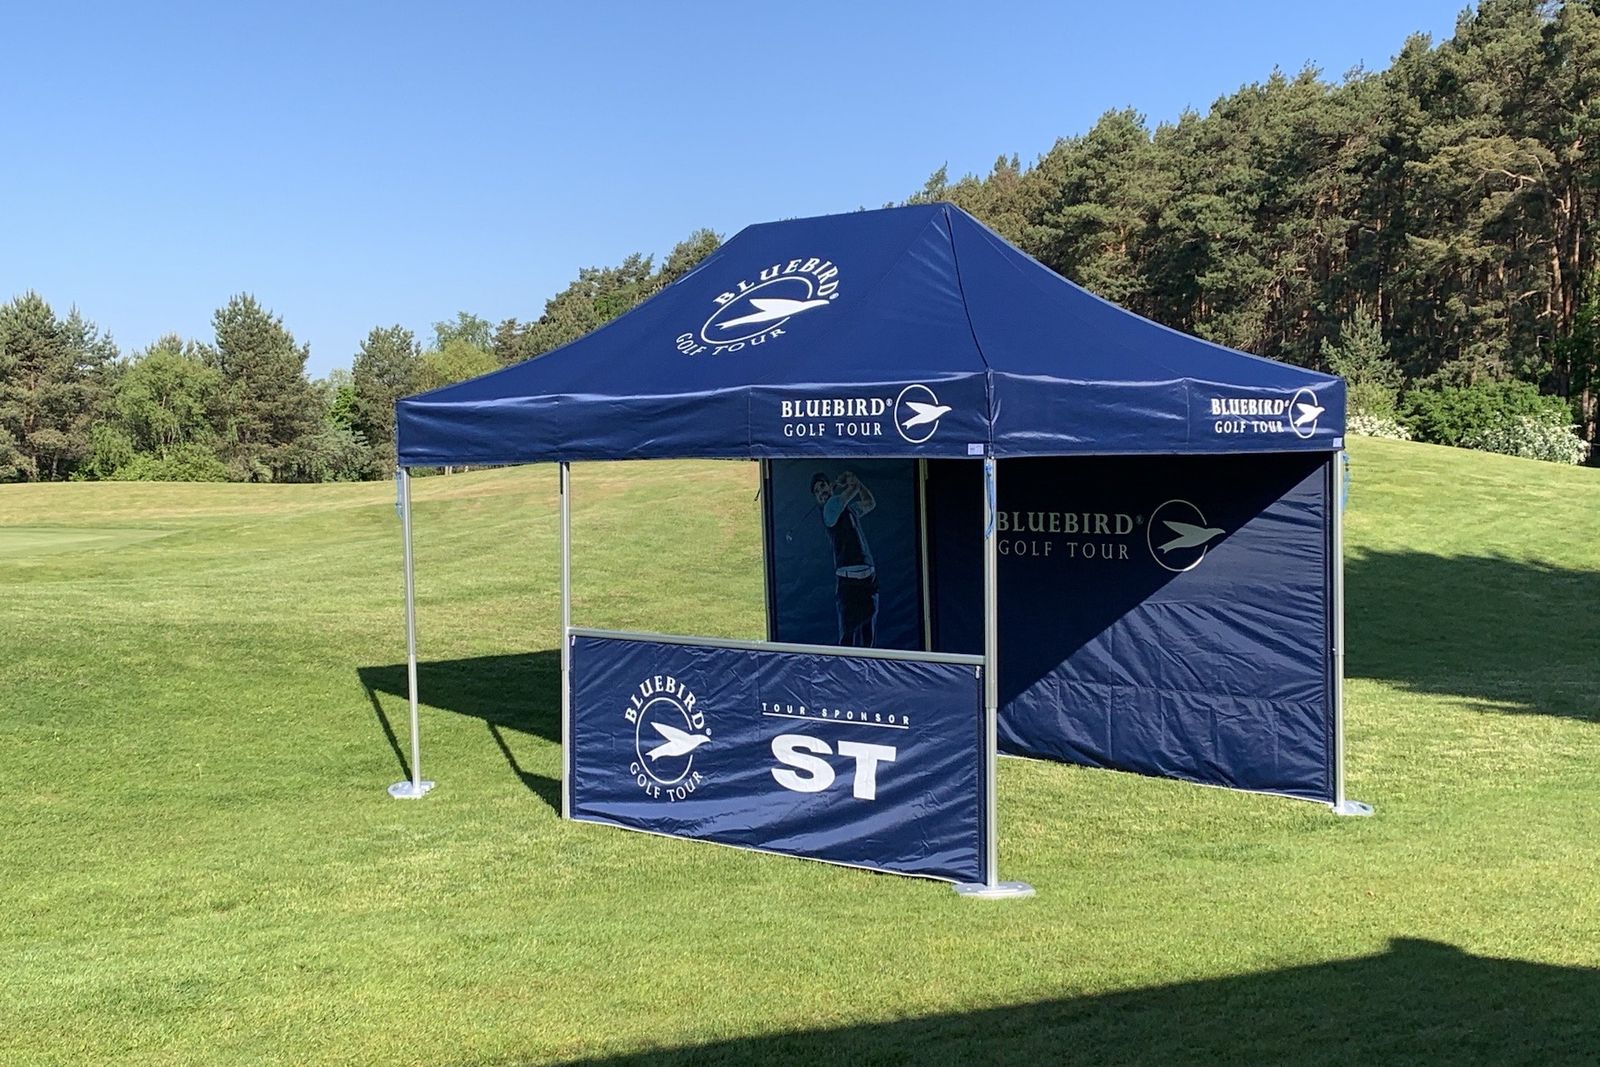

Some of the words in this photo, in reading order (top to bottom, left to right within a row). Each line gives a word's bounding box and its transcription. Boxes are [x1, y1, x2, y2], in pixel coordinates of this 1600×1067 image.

[676, 333, 707, 356] GOLF
[712, 329, 786, 356] TOUR
[784, 424, 826, 437] GOLF
[836, 423, 882, 436] TOUR
[1215, 421, 1246, 433] GOLF
[1252, 421, 1284, 433] TOUR
[998, 540, 1052, 556] GOLF
[1067, 542, 1129, 560] TOUR
[762, 702, 805, 715] TOUR
[822, 708, 909, 725] SPONSOR
[771, 734, 897, 800] ST
[630, 762, 661, 799] GOLF
[667, 771, 703, 802] TOUR
